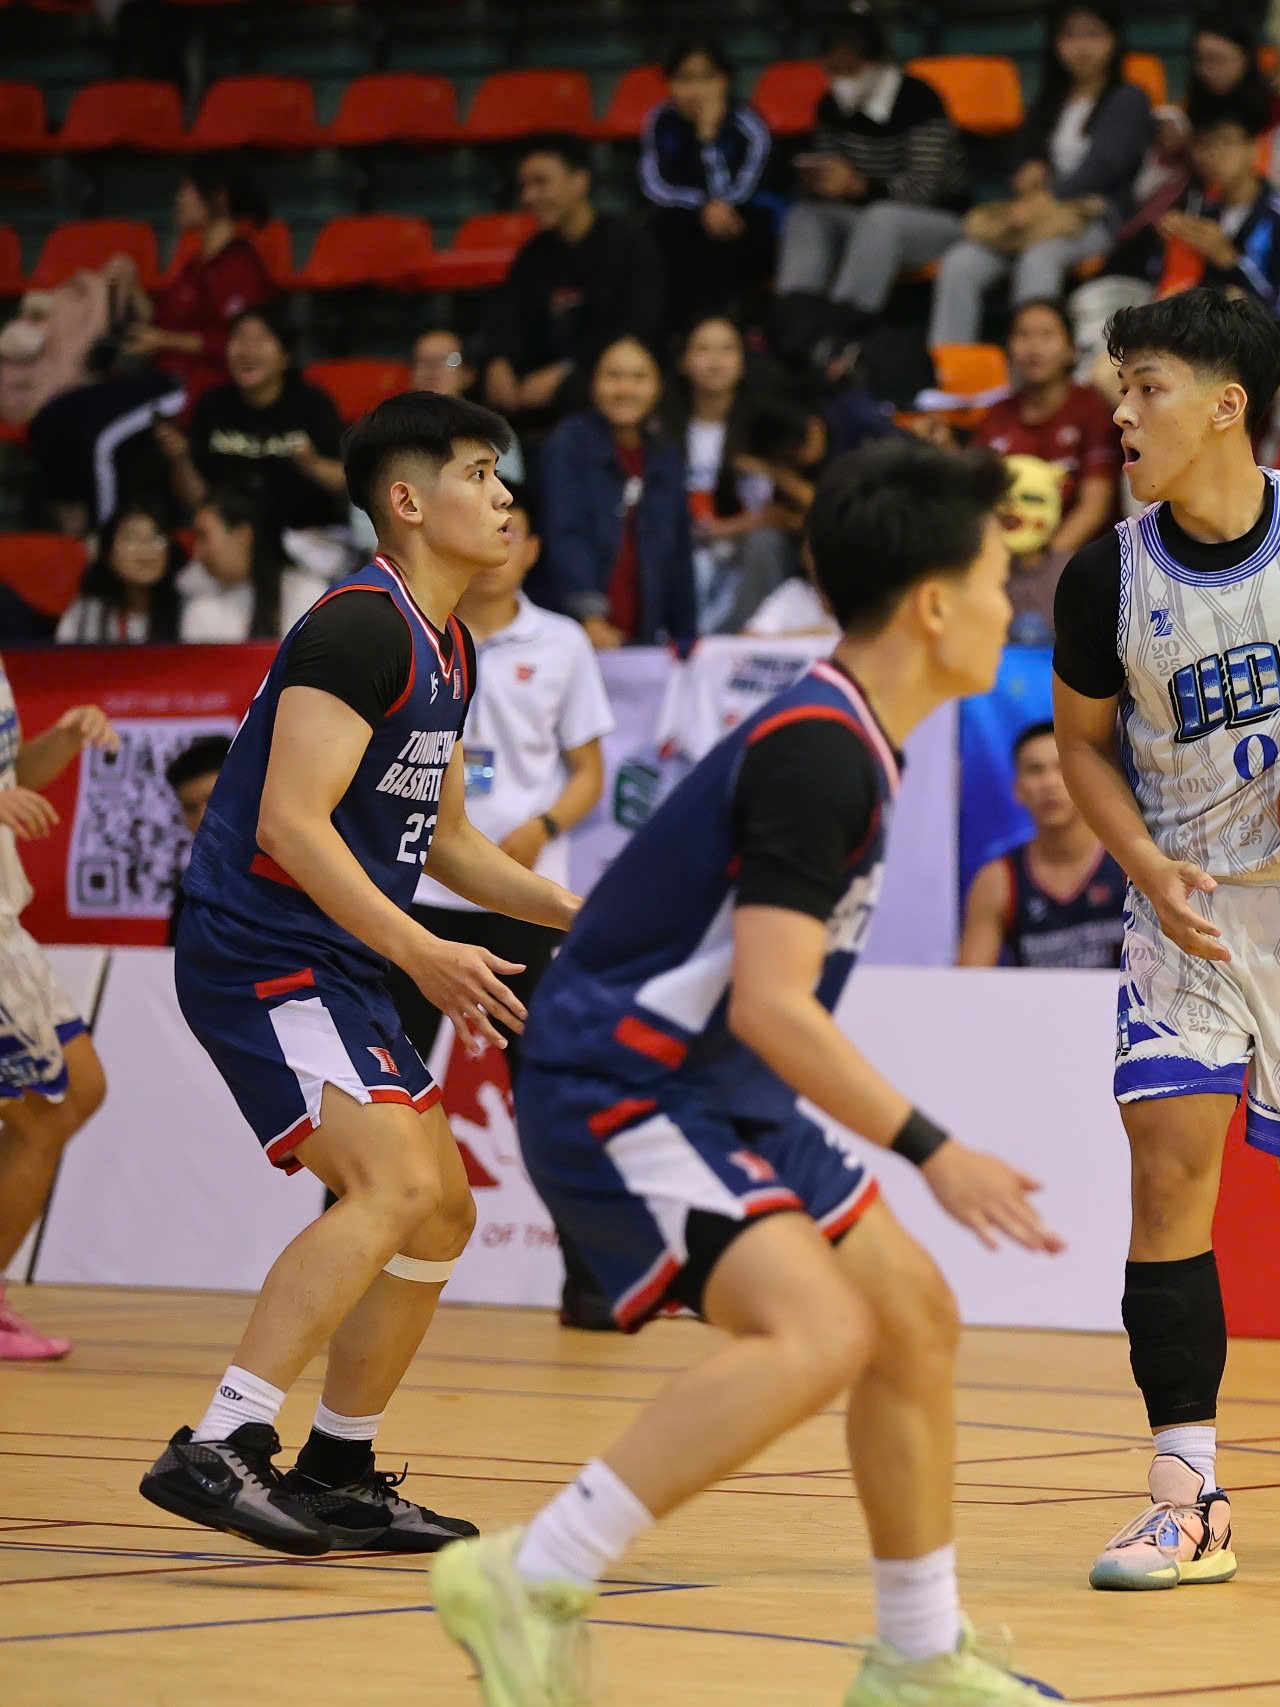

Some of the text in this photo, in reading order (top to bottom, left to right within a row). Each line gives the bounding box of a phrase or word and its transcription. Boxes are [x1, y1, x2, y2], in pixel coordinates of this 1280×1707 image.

[1151, 639, 1181, 660] 20
[1239, 813, 1265, 831] 20
[1239, 830, 1264, 848] 25
[1186, 1000, 1211, 1018] 20
[1188, 1017, 1211, 1035] 25
